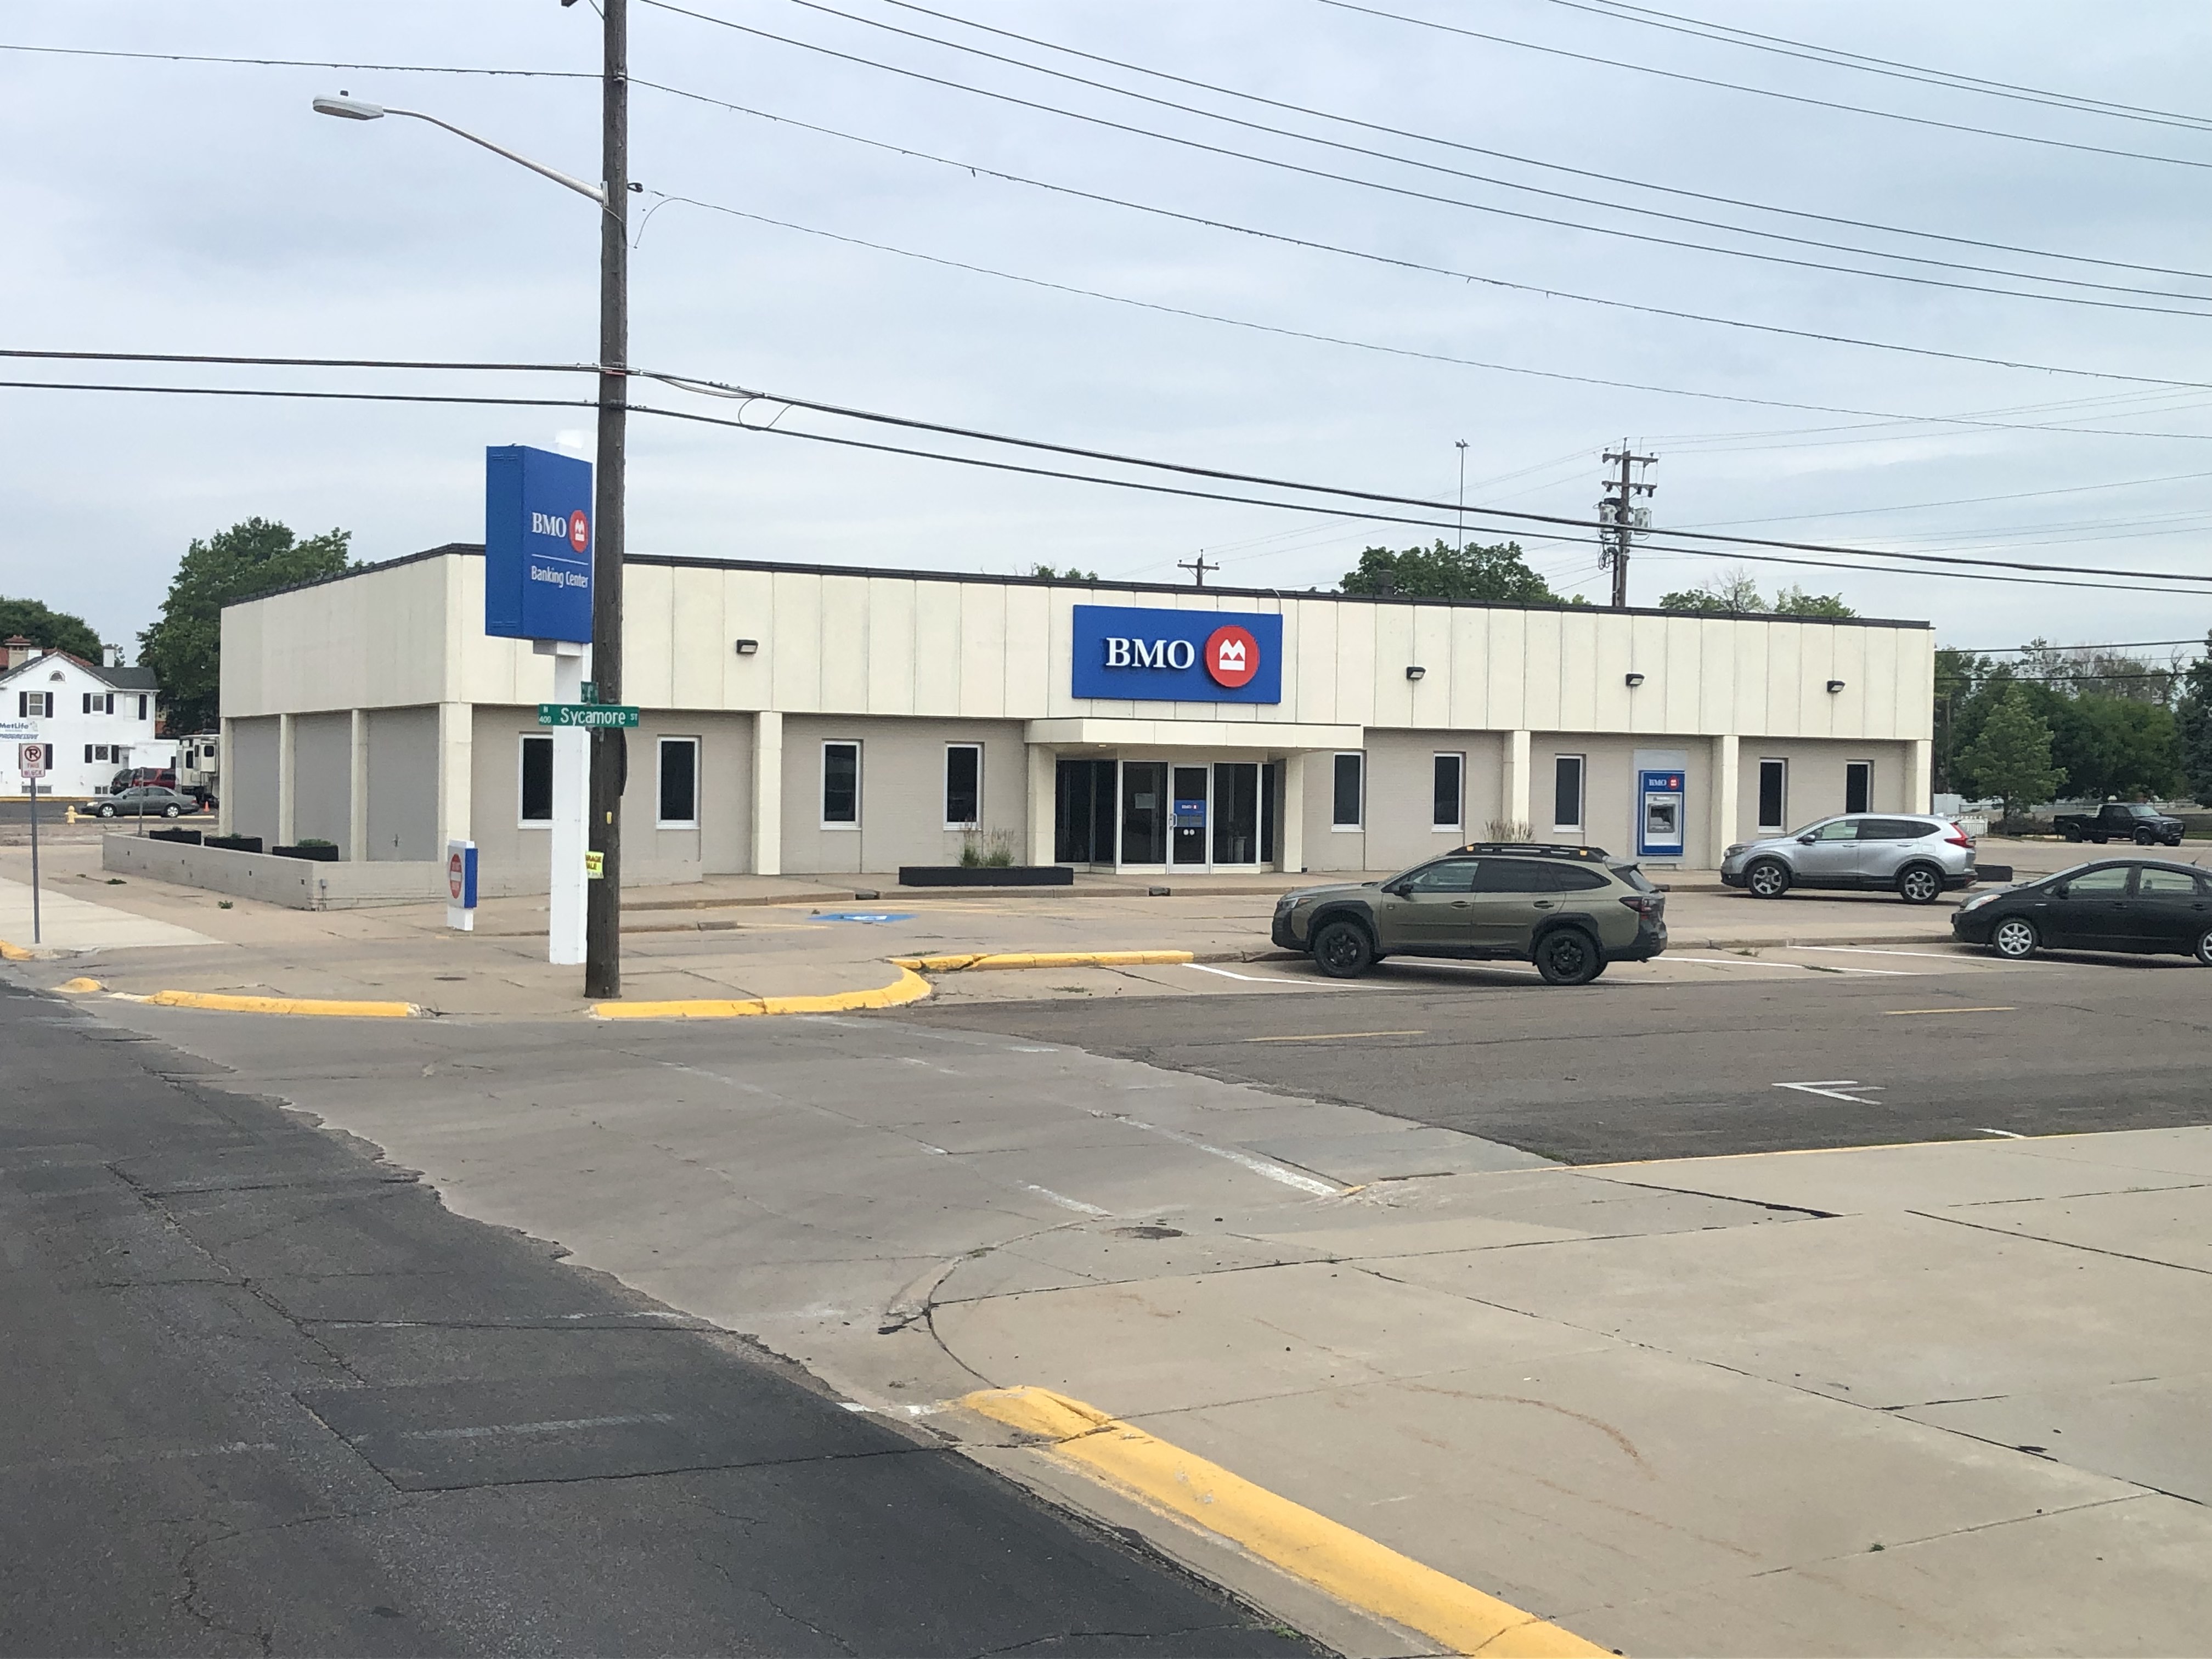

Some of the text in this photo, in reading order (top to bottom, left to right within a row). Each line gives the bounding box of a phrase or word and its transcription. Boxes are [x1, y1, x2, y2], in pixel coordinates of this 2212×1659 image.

[532, 512, 567, 538] BMO
[531, 565, 589, 588] Banking Center
[1106, 637, 1195, 669] BMO
[560, 707, 626, 726] Sycamore
